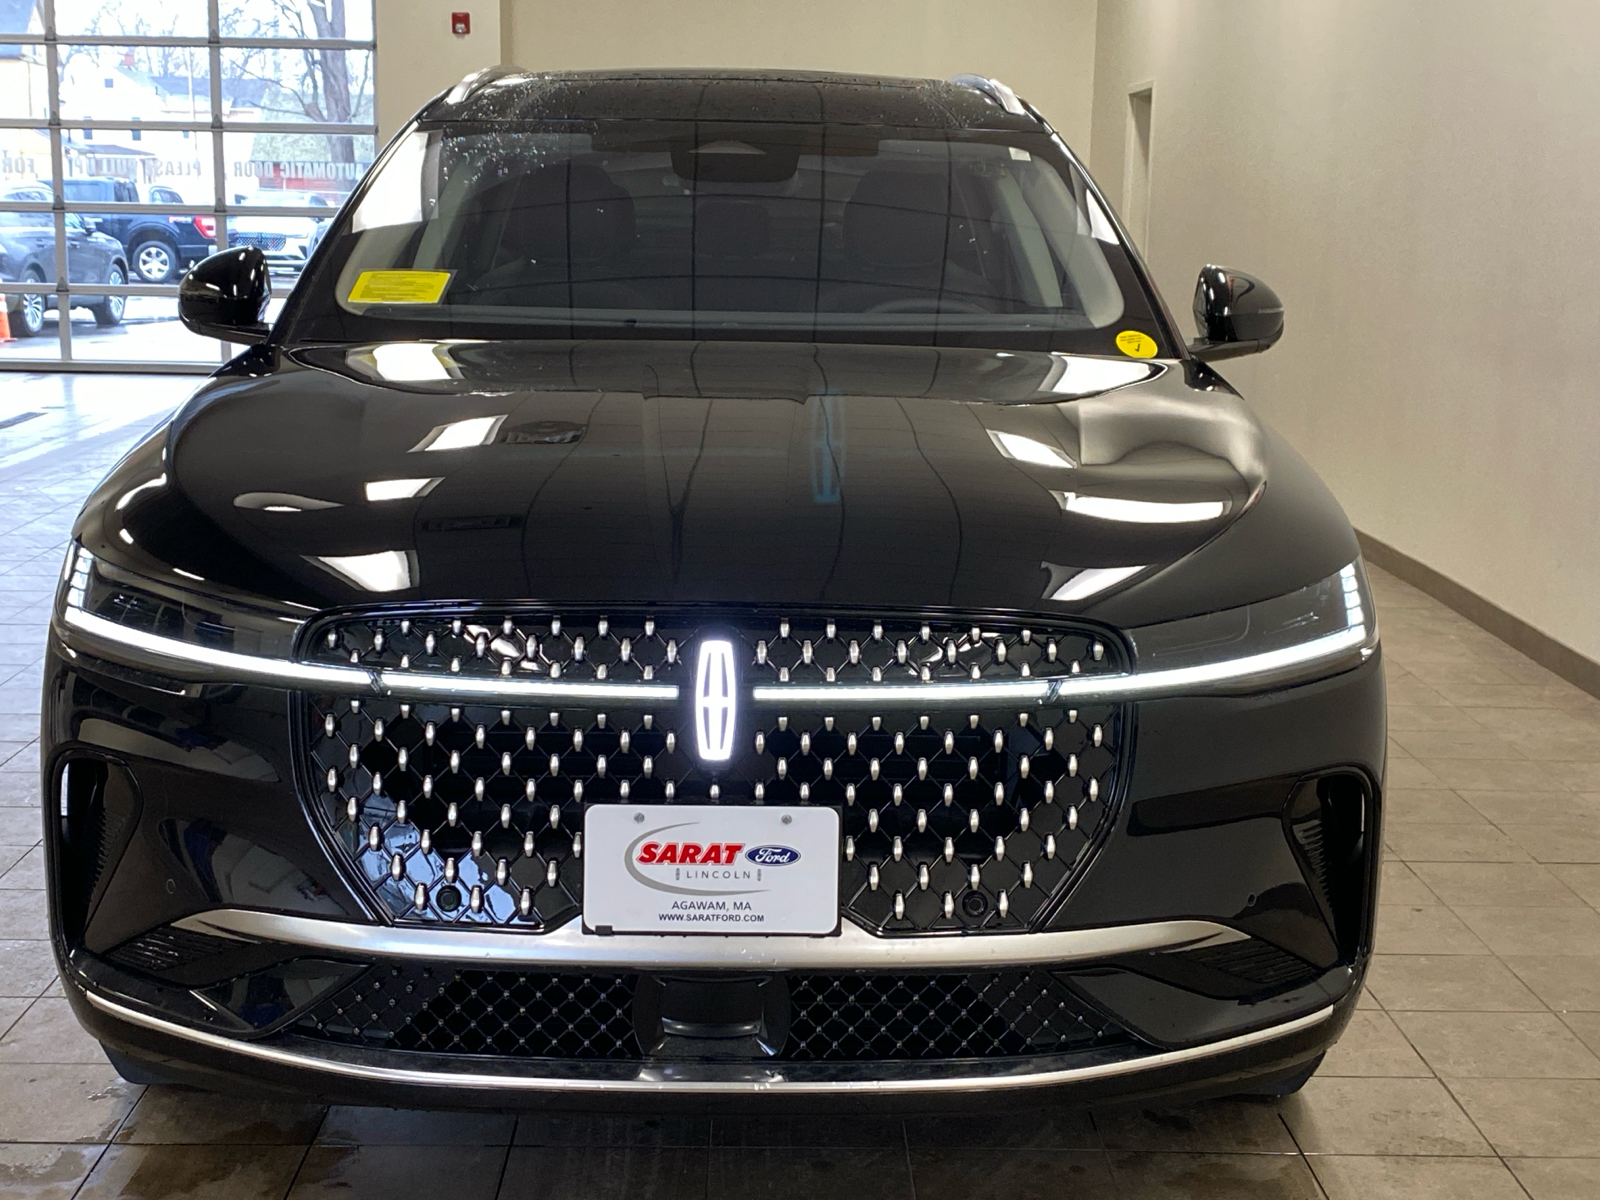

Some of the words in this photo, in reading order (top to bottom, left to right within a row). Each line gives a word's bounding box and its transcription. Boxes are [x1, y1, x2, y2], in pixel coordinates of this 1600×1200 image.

[636, 841, 746, 866] SARAT
[754, 847, 791, 863] Ford
[686, 870, 751, 880] LINCOLN
[671, 901, 730, 912] AGAWAM,
[732, 901, 752, 911] MA
[658, 913, 765, 923] WWW.SARATFORD.COM
